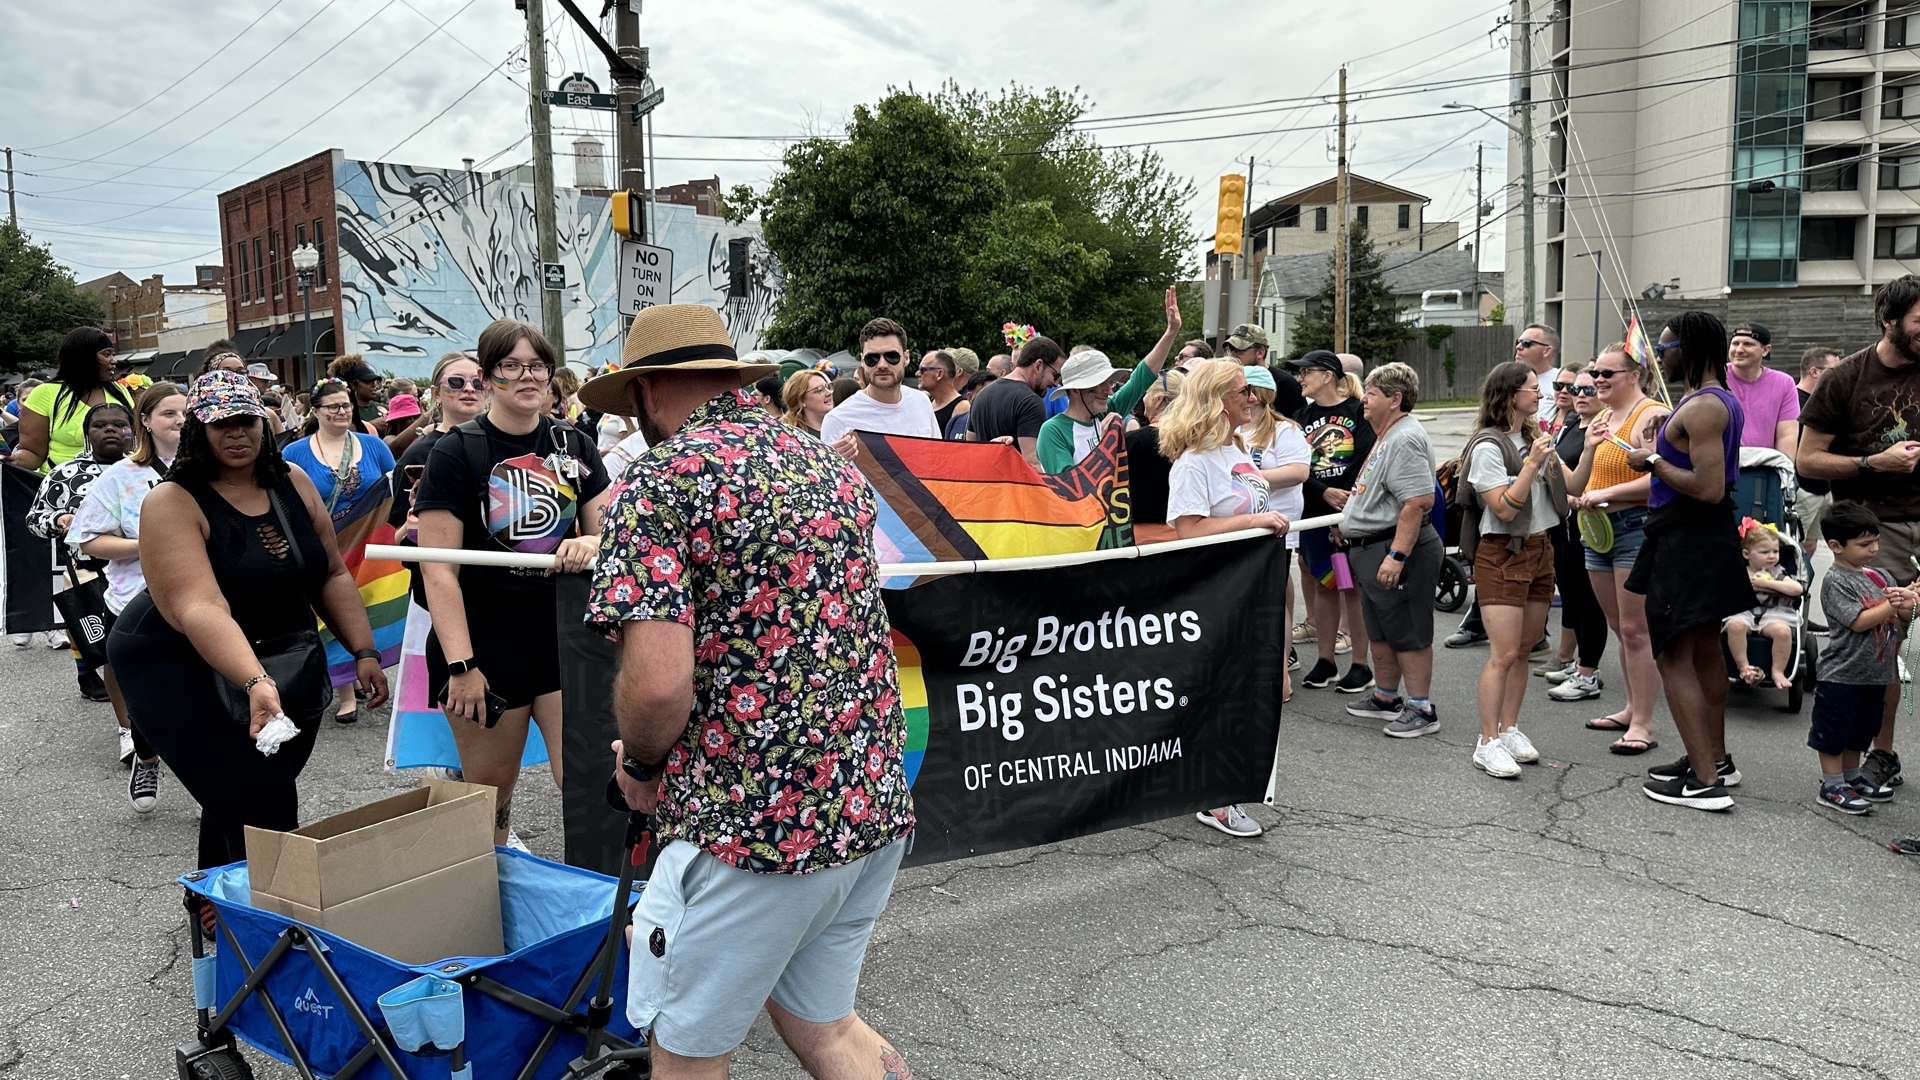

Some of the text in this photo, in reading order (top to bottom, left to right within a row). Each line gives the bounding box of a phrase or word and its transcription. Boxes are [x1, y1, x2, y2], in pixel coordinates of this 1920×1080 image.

[567, 93, 592, 106] East
[635, 249, 659, 267] NO
[631, 266, 662, 284] TURN
[637, 284, 654, 298] ON
[1303, 416, 1326, 437] ORE
[959, 606, 1202, 674] Big Brothers
[956, 681, 1025, 742] Big
[964, 736, 1183, 791] OF CENTRAL INDIANA
[294, 996, 334, 1019] QUEST
